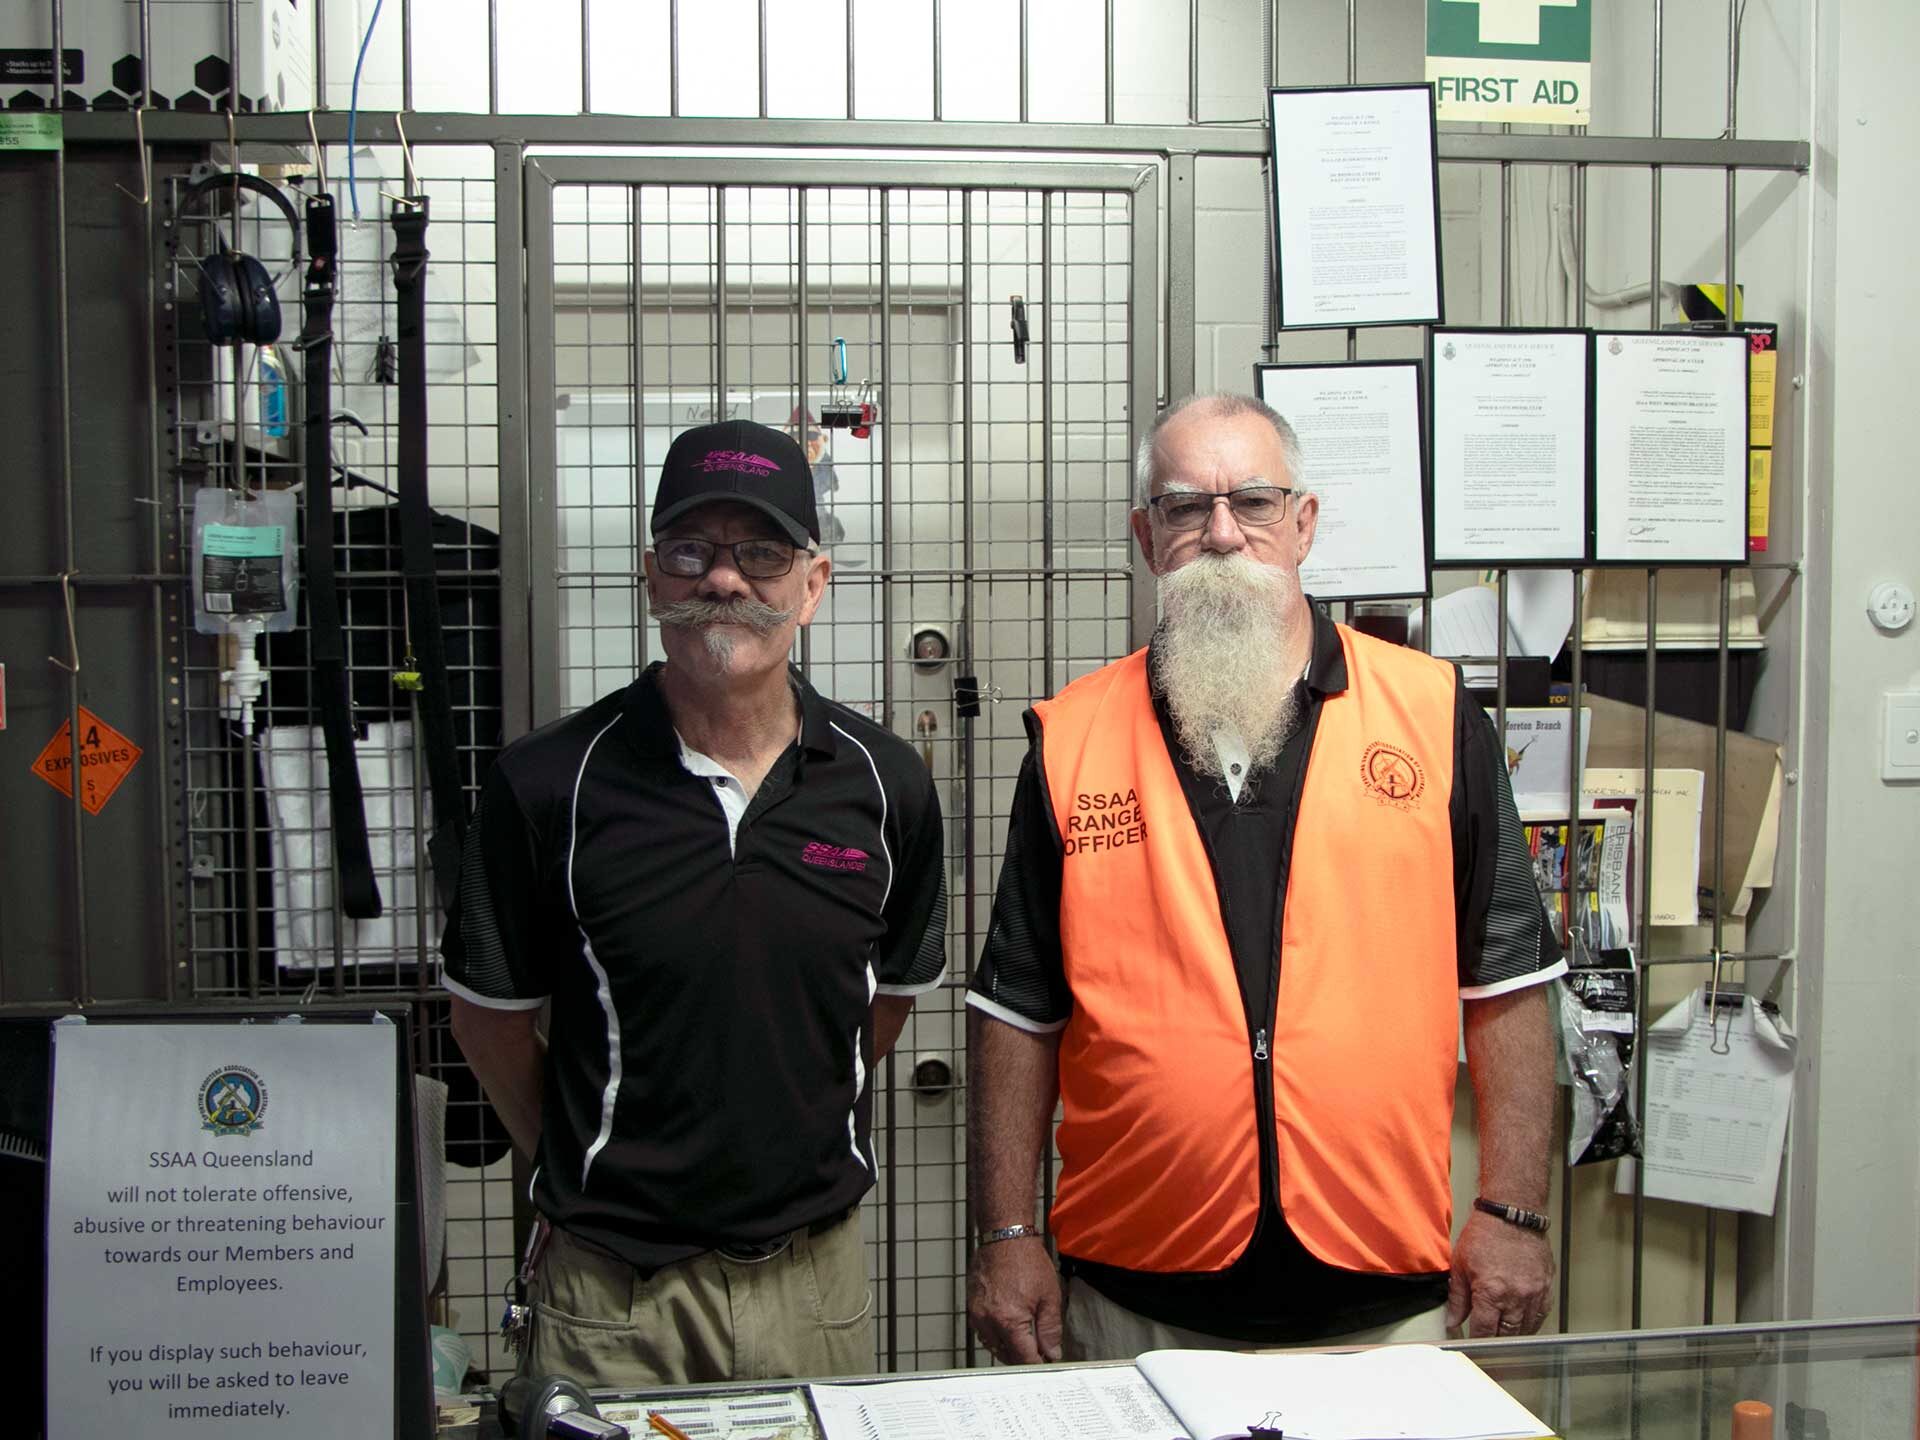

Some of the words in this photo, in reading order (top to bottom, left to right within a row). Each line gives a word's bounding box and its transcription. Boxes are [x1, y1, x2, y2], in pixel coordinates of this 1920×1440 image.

[1438, 76, 1518, 103] FIRST
[1532, 80, 1579, 105] AID
[687, 403, 740, 418] Ned
[704, 463, 769, 477] QUEENSLAND
[1536, 720, 1561, 731] Branch
[45, 748, 130, 772] EXPOSIVES
[87, 779, 95, 791] S
[91, 795, 97, 805] 1
[1077, 788, 1137, 811] SSAA
[1068, 803, 1142, 834] RANGE
[1064, 821, 1148, 856] OFFICER
[1611, 825, 1626, 905] BRISBANE
[149, 1151, 197, 1168] SSAA
[202, 1150, 313, 1169] Queensland
[107, 1186, 139, 1203] will
[145, 1188, 177, 1202] not
[183, 1185, 257, 1202] tolerate
[263, 1184, 353, 1203] offensive,
[73, 1216, 145, 1234] abusive
[151, 1220, 170, 1233] or
[177, 1215, 286, 1235] threatening
[292, 1213, 386, 1231] behaviour
[104, 1245, 181, 1263] towards
[187, 1250, 218, 1262] our
[225, 1244, 314, 1262] Members
[319, 1243, 354, 1260] and
[177, 1274, 283, 1295] Employees.
[90, 1346, 103, 1362] If
[108, 1350, 142, 1366] you
[149, 1344, 215, 1363] display
[220, 1343, 262, 1360] such
[268, 1341, 367, 1359] behaviour,
[108, 1378, 143, 1395] you
[149, 1373, 181, 1391] will
[188, 1373, 210, 1389] be
[216, 1371, 269, 1388] asked
[275, 1373, 294, 1387] to
[300, 1369, 349, 1387] leave
[168, 1400, 290, 1420] immediately.
